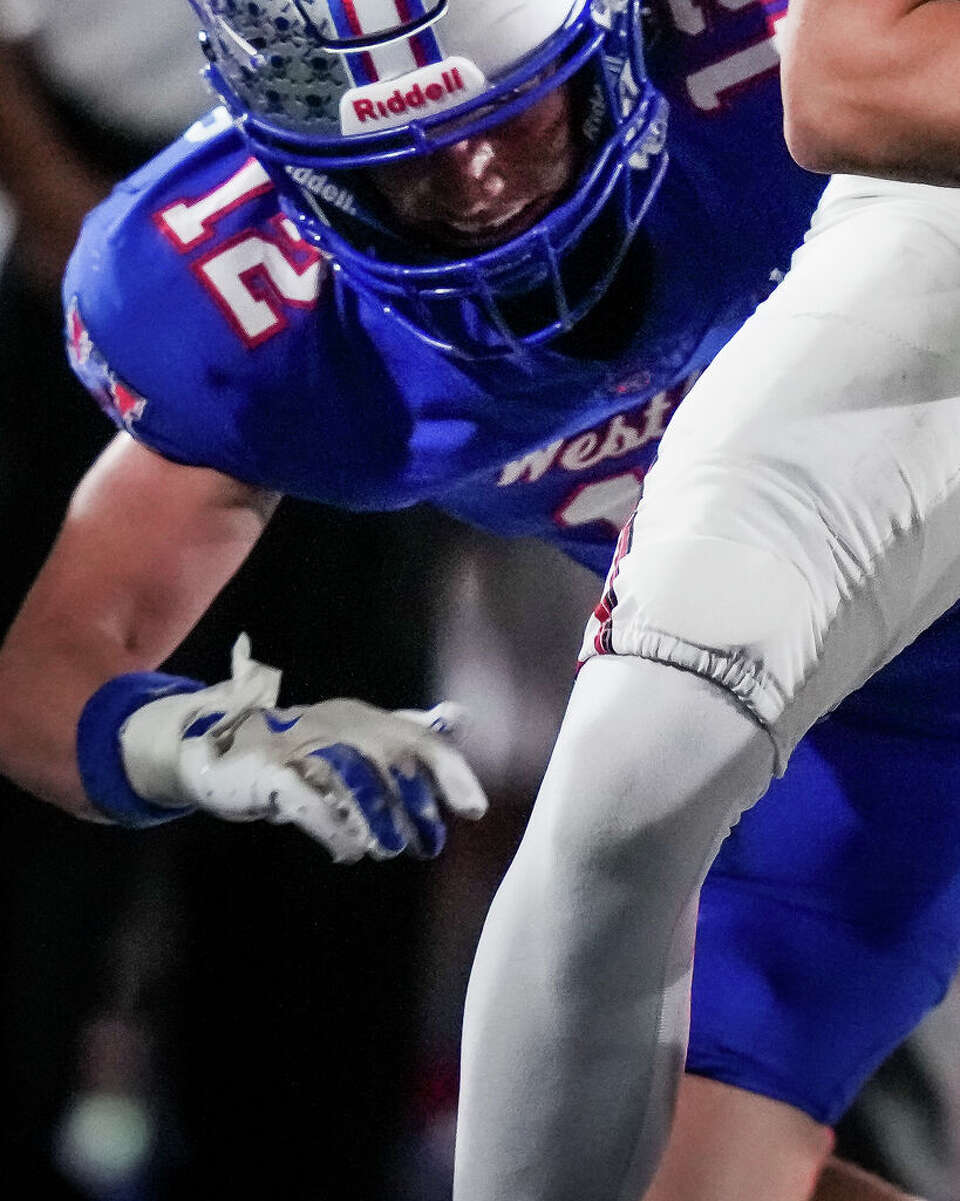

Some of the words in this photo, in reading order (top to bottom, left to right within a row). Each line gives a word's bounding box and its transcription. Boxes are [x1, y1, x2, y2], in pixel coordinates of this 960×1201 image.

[352, 67, 464, 123] Riddell
[152, 156, 324, 351] 12
[496, 382, 690, 488] West
